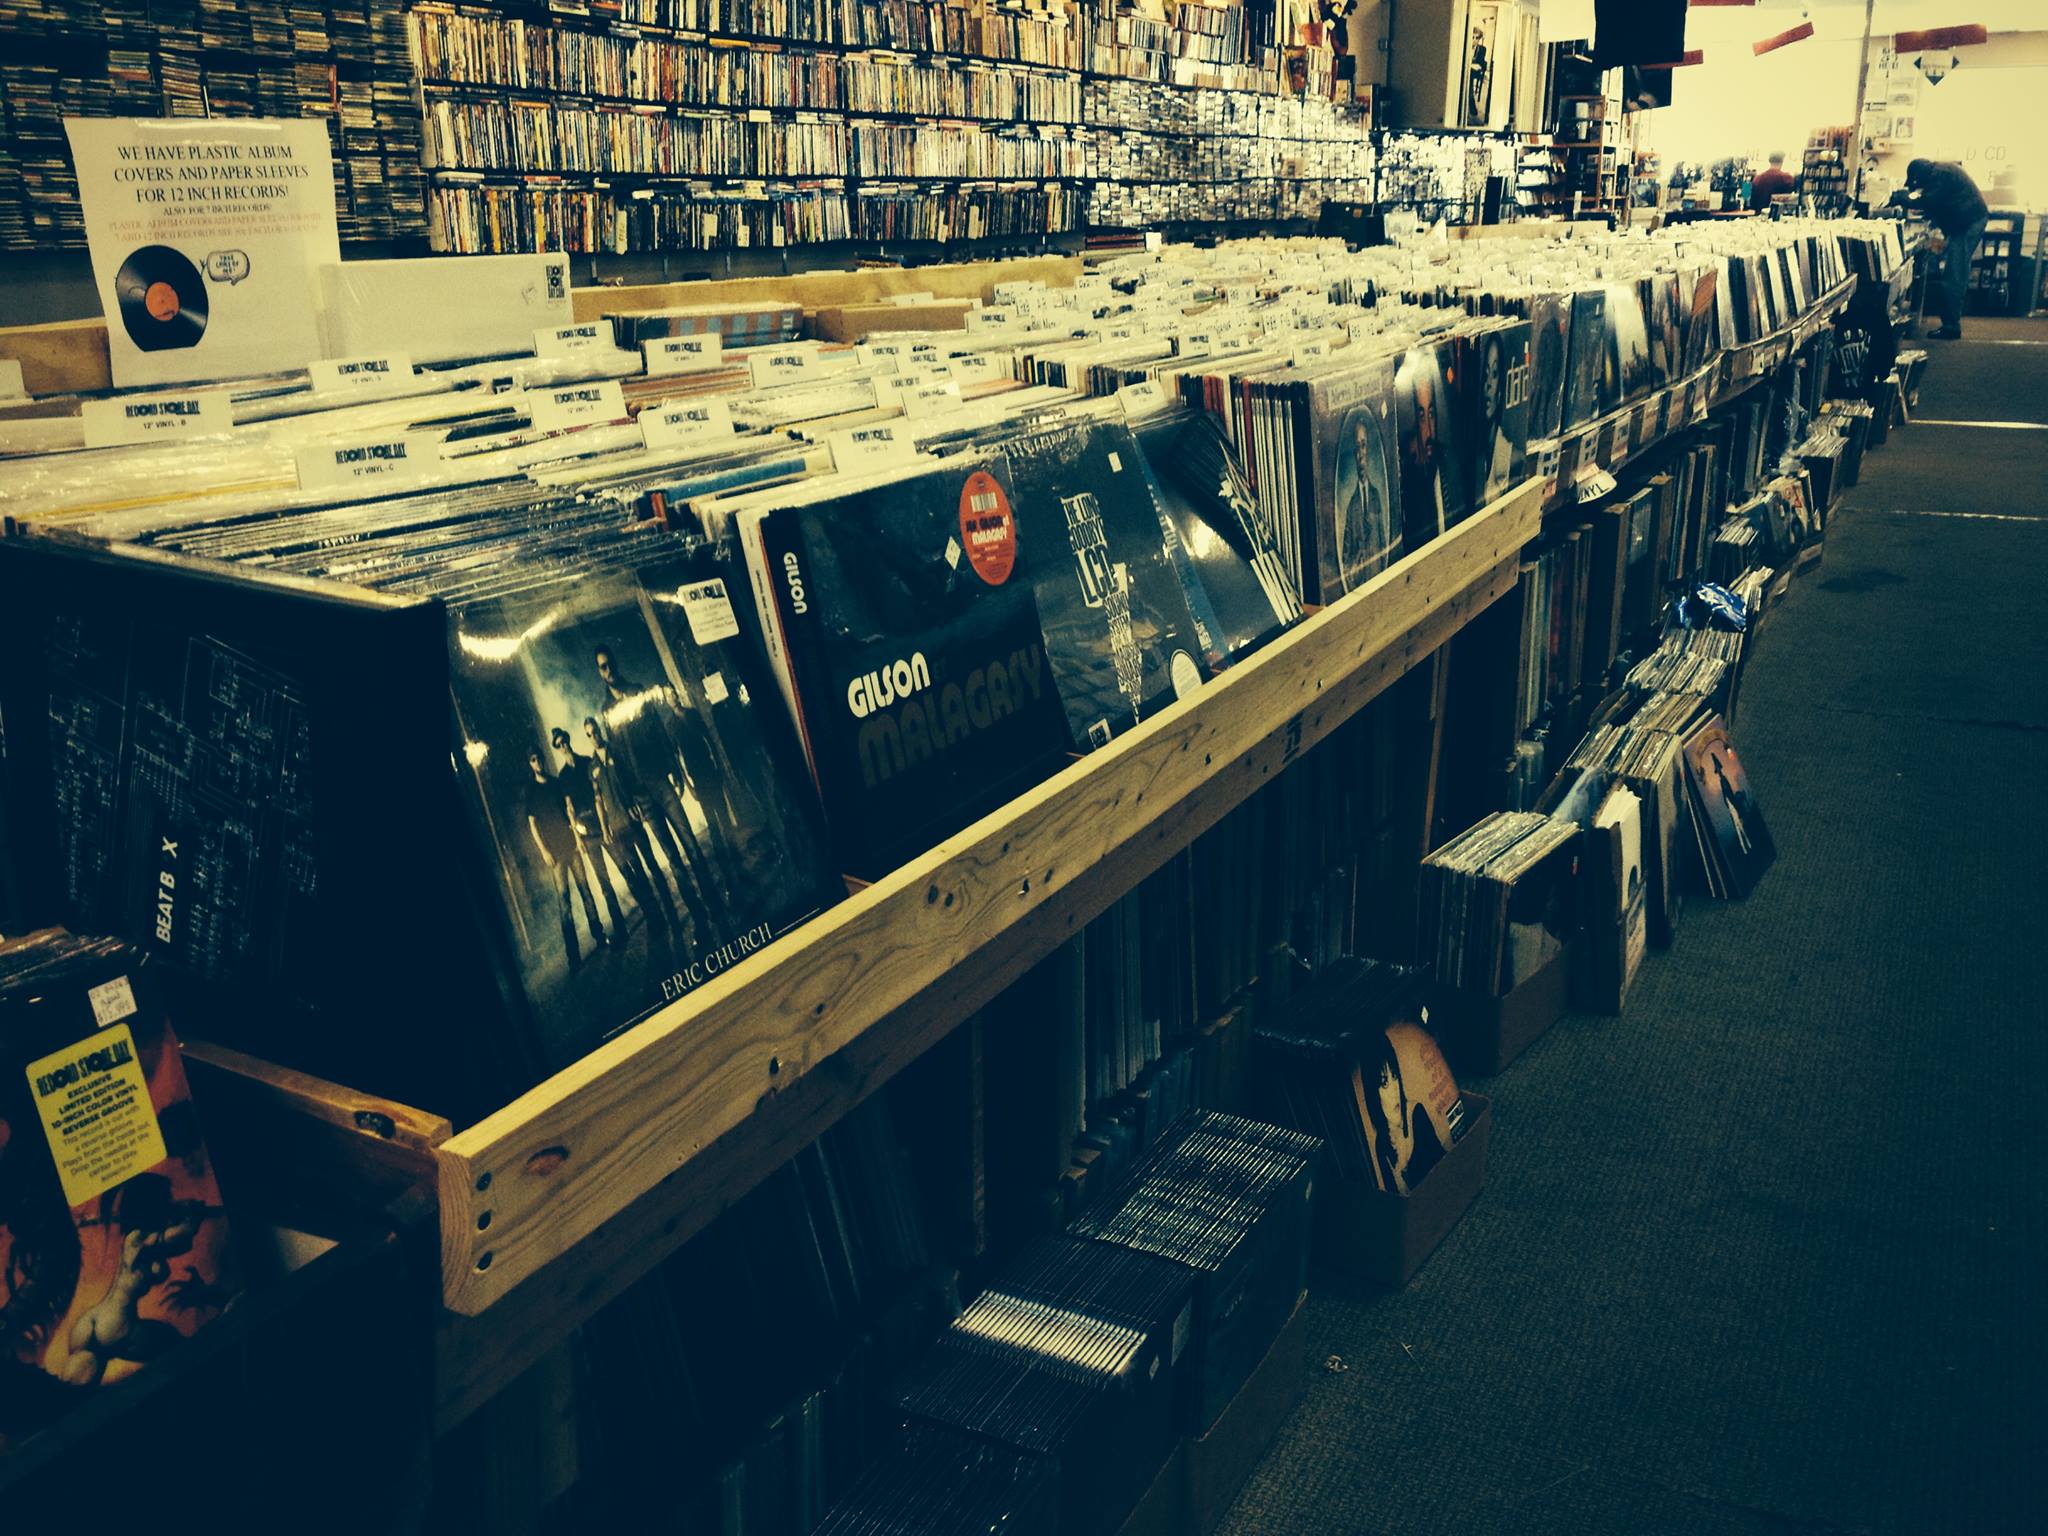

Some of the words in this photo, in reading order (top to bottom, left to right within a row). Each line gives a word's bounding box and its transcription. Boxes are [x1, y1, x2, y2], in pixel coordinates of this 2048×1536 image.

[118, 146, 142, 160] WE
[145, 145, 186, 160] HAVE
[189, 145, 241, 160] PLASTIC
[248, 145, 293, 159] ALBUM
[114, 167, 173, 182] COVERS
[178, 166, 208, 181] AND
[212, 165, 251, 180] PAPER
[256, 164, 309, 178] SLEEVES
[136, 188, 166, 203] FOR
[171, 187, 184, 201] 12
[188, 186, 221, 200] INCH
[224, 184, 289, 199] RECORDS!
[163, 206, 186, 216] ALSO
[188, 206, 204, 215] FOR
[126, 403, 158, 417] RECORD
[159, 401, 187, 415] STORE
[187, 400, 200, 415] DAY
[156, 420, 176, 429] VINYL
[336, 448, 367, 464] RECORD
[367, 444, 393, 460] STORE
[393, 442, 407, 458] DAY
[365, 465, 384, 474] VINYL
[783, 552, 807, 614] GILSON
[847, 651, 931, 719] GILSON
[858, 643, 1042, 790] MALAGASY
[661, 962, 703, 1000] ERIC
[705, 922, 772, 975] CHURCH
[36, 1062, 80, 1097] RECORD
[79, 1046, 114, 1077] STORE
[112, 1039, 134, 1064] DAY
[58, 1095, 92, 1115] LIMITED
[93, 1078, 126, 1098] EDITION
[67, 1073, 112, 1099] EXCLUSIVE
[51, 1109, 85, 1129] 10-INCH
[86, 1095, 113, 1114] COLOR
[115, 1083, 138, 1099] VINYL
[62, 1115, 100, 1135] REVERSE
[101, 1097, 135, 1116] GROOVE
